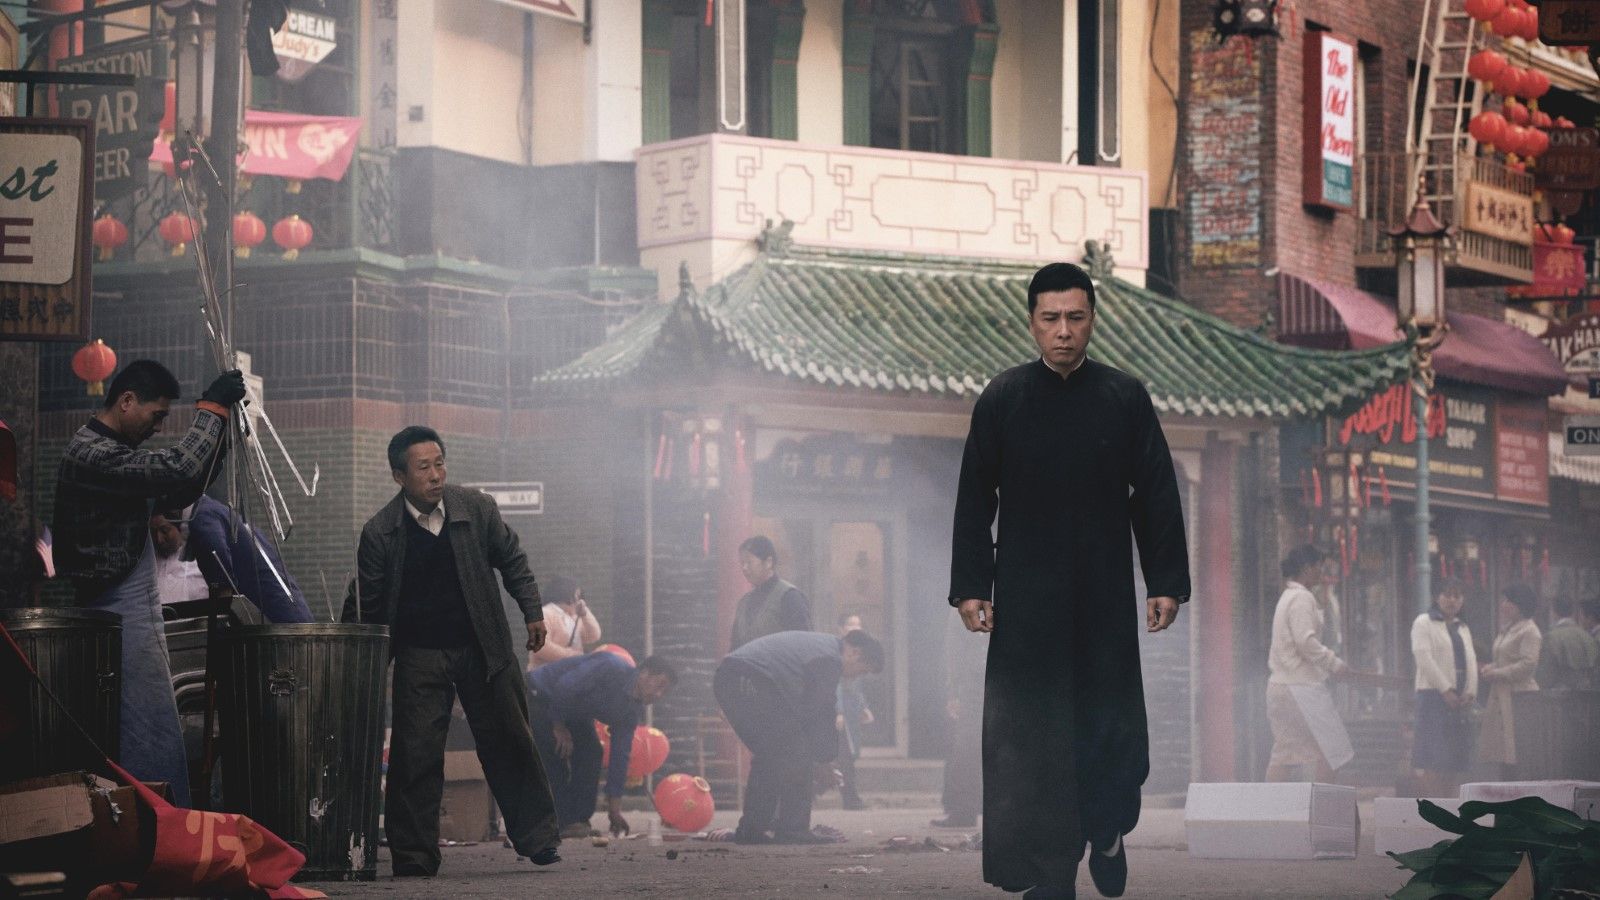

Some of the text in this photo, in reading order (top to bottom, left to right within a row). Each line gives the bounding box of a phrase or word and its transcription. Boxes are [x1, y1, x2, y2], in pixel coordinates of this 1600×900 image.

[288, 11, 336, 41] CREAM
[1327, 49, 1347, 78] The
[0, 217, 34, 264] E
